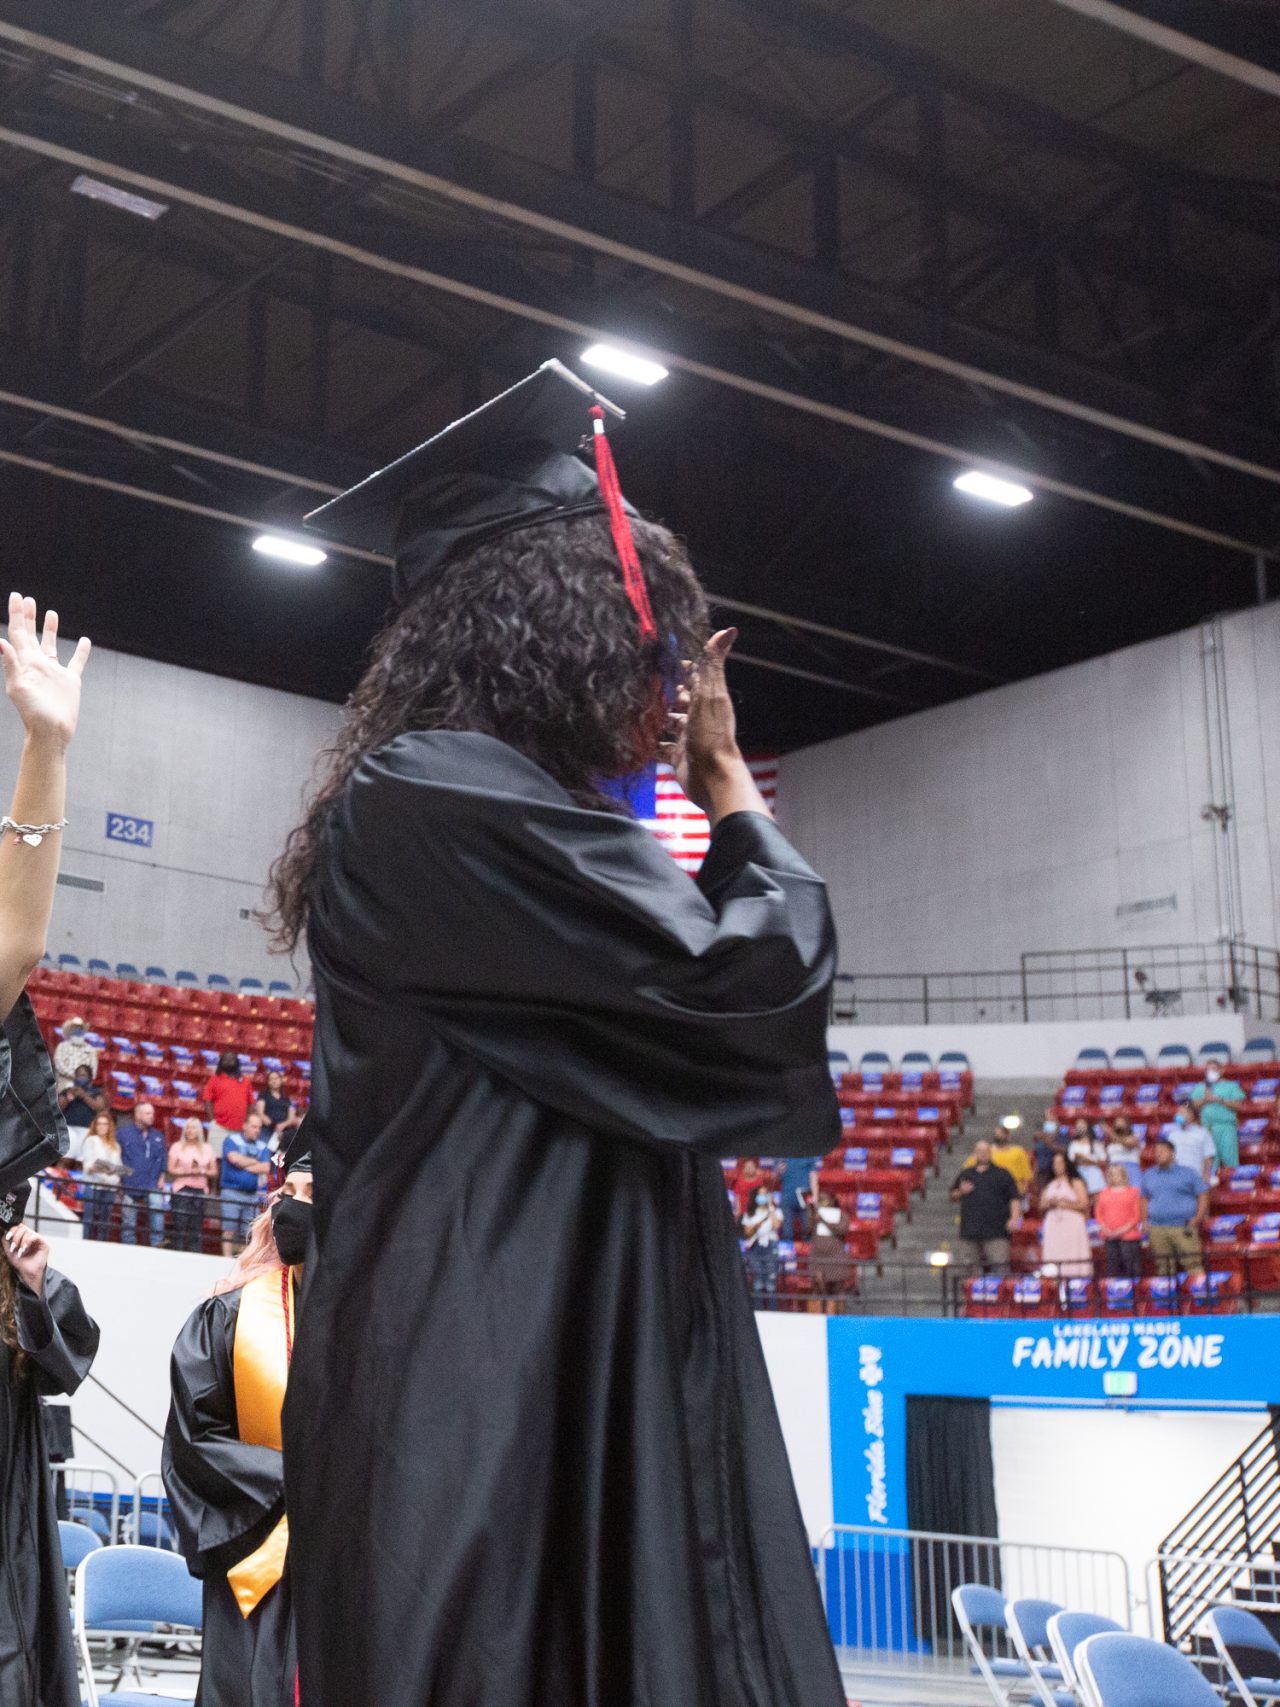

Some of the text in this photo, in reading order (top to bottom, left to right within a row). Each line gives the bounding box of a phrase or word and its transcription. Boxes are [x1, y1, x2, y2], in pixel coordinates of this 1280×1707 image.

[111, 817, 149, 844] 234
[1053, 1321, 1181, 1338] LAKELAND MAGIC
[1012, 1334, 1225, 1369] FAMILY ZONE
